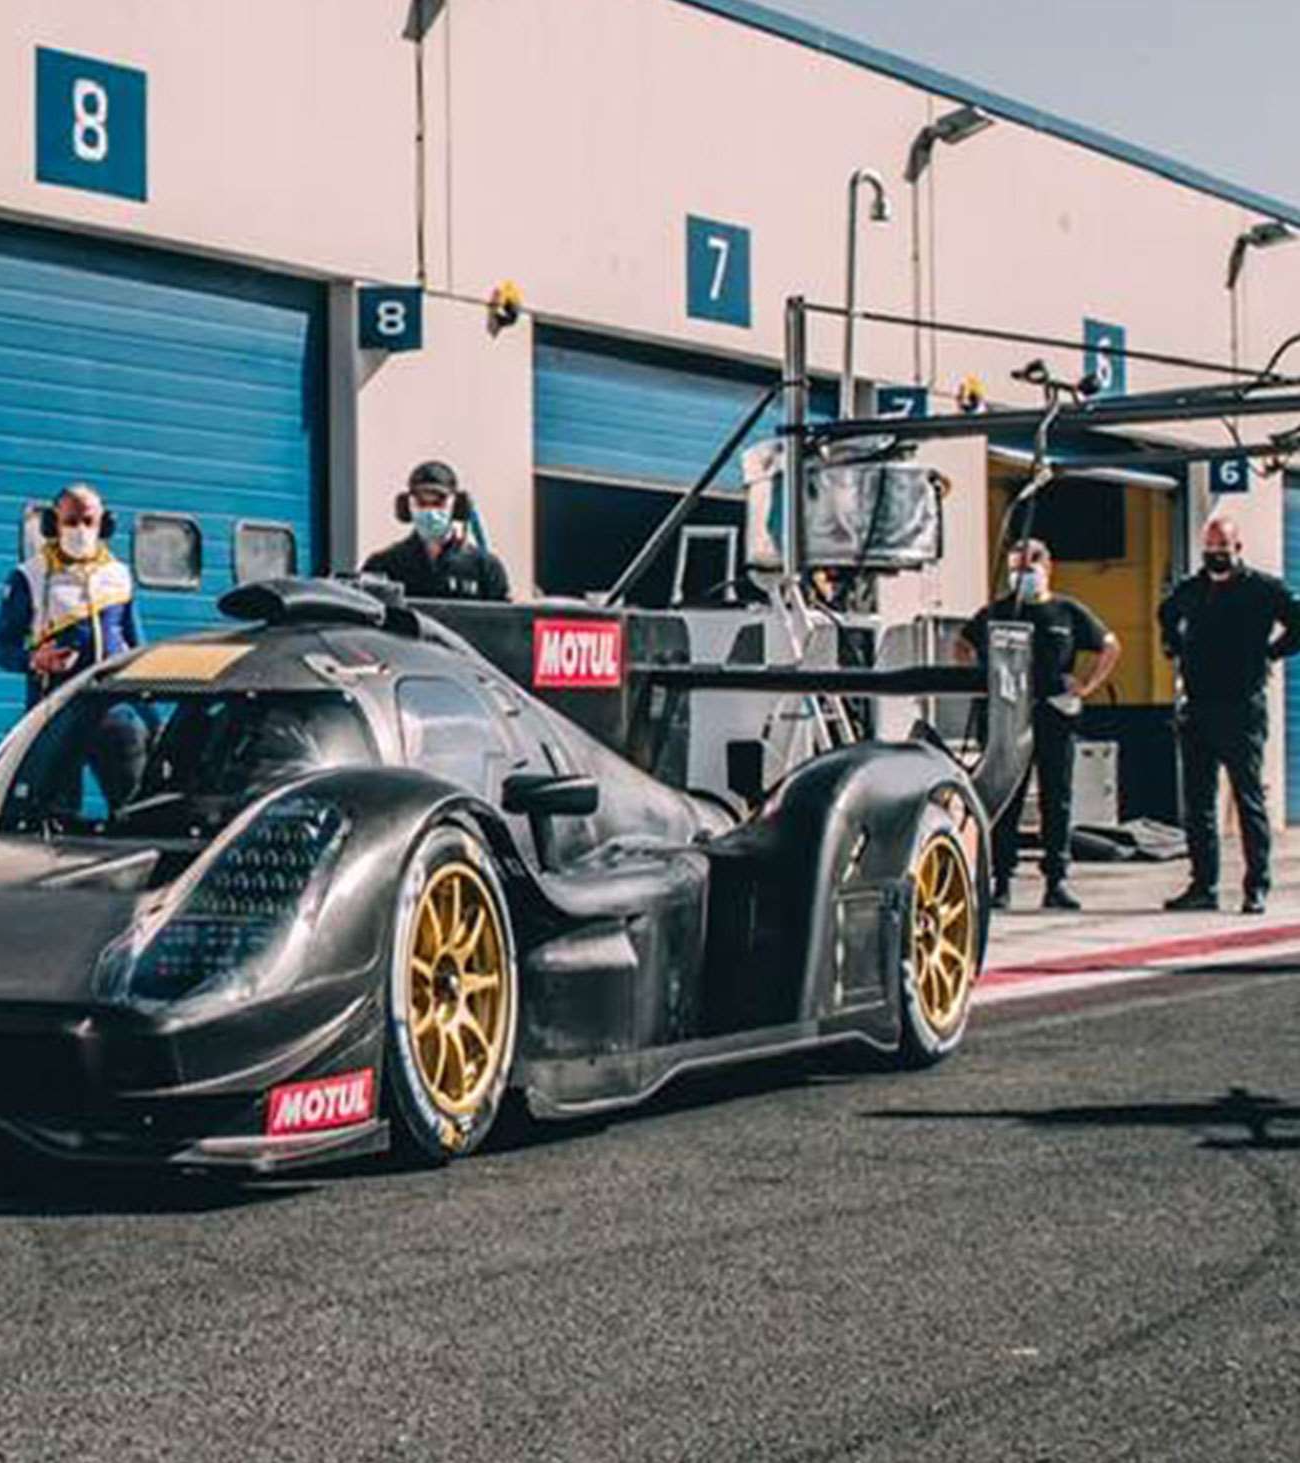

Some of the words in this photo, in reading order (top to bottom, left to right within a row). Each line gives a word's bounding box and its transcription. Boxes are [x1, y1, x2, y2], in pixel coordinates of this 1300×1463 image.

[74, 78, 107, 162] 8
[707, 236, 729, 300] 7
[377, 302, 406, 335] 8
[1220, 461, 1240, 485] 6
[538, 630, 617, 677] MOTUL
[273, 1080, 366, 1130] MOTUL
